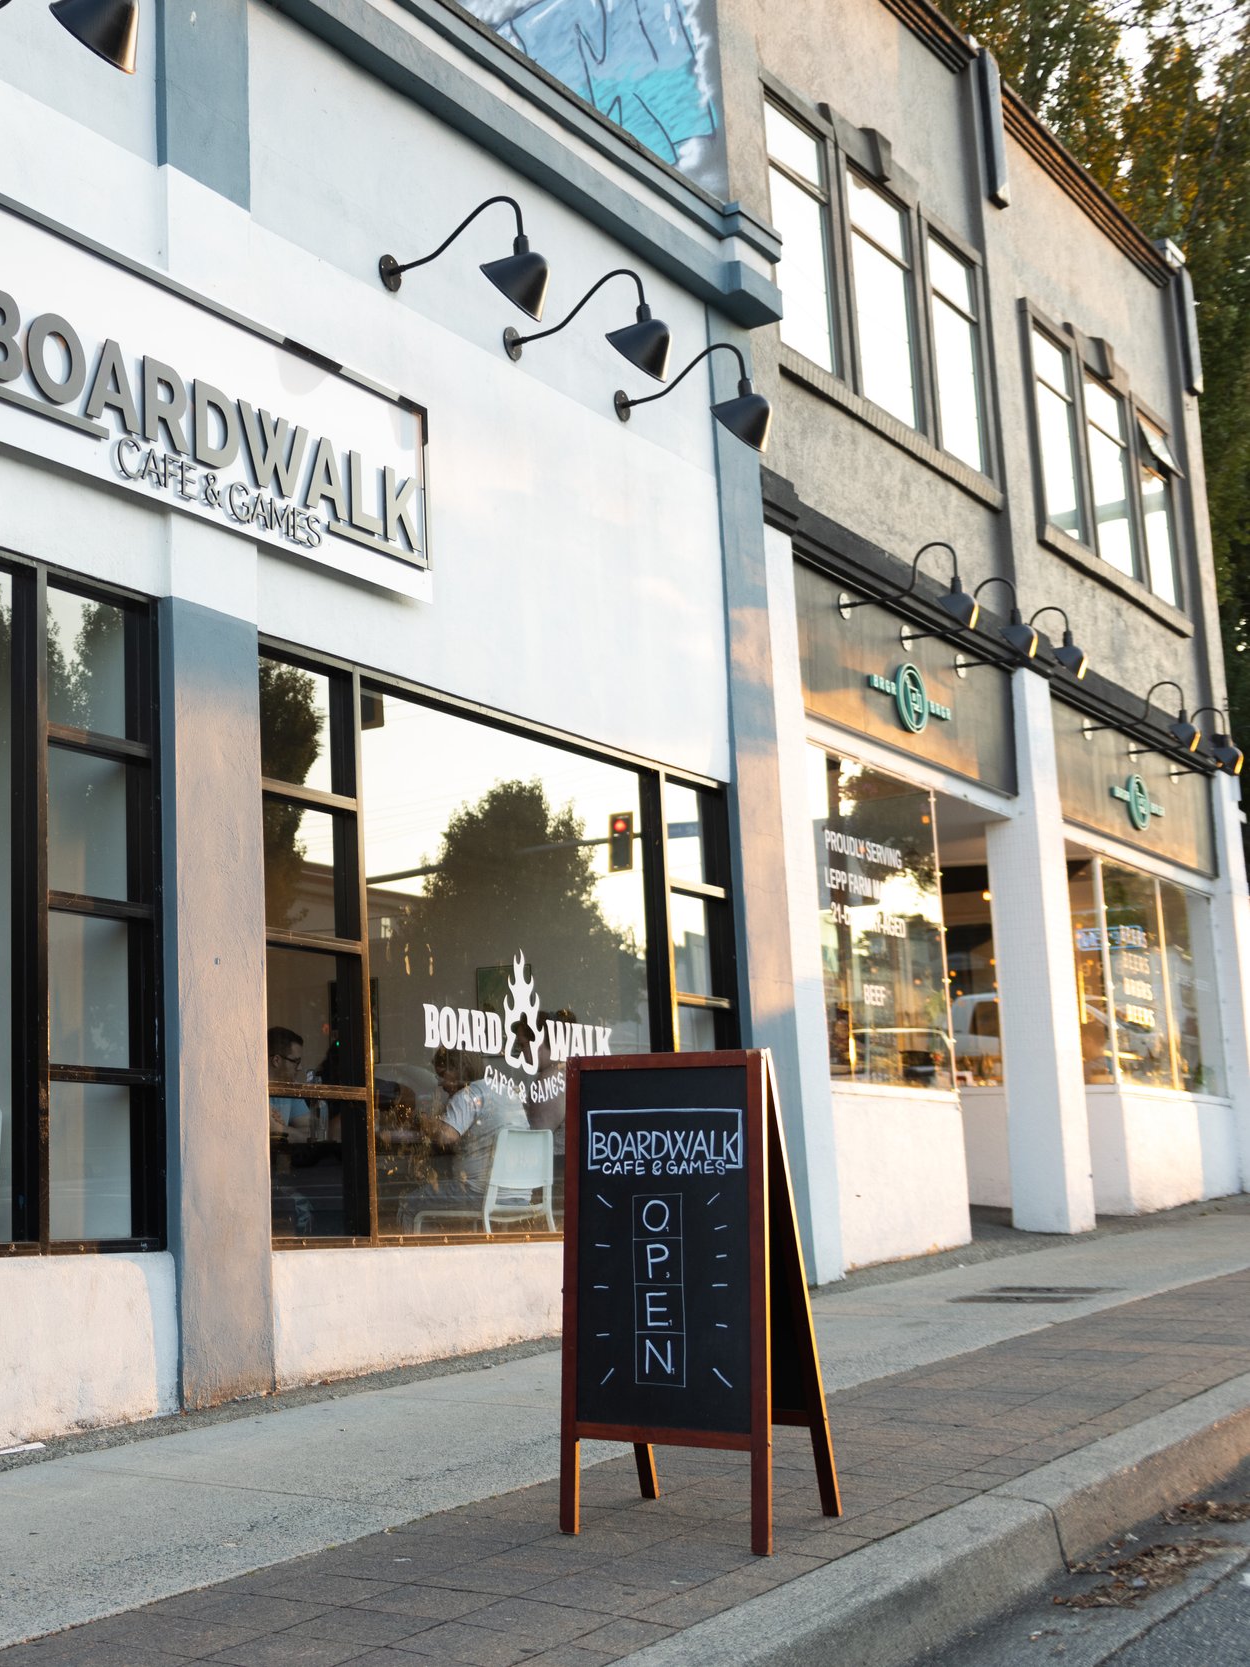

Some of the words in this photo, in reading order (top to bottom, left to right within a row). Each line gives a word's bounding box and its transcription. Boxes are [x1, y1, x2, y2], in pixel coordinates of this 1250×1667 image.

[117, 436, 199, 500] CAFE
[205, 472, 223, 508] &
[230, 481, 324, 548] GAMES
[824, 829, 865, 860] PROUDLY
[865, 841, 903, 870] SERVING
[824, 866, 847, 891] LEPP
[848, 873, 871, 898] FARM
[863, 983, 886, 1007] BEEF
[423, 1003, 503, 1055] BOARD
[545, 1019, 613, 1063] WALK
[484, 1064, 515, 1100] CAFE
[518, 1080, 528, 1104] &
[530, 1071, 566, 1103] GAMES
[592, 1130, 738, 1163] BOARDWALK
[602, 1160, 646, 1175] CAFE
[652, 1160, 662, 1176] &
[666, 1160, 726, 1175] GAMES
[642, 1199, 672, 1375] OPEN
